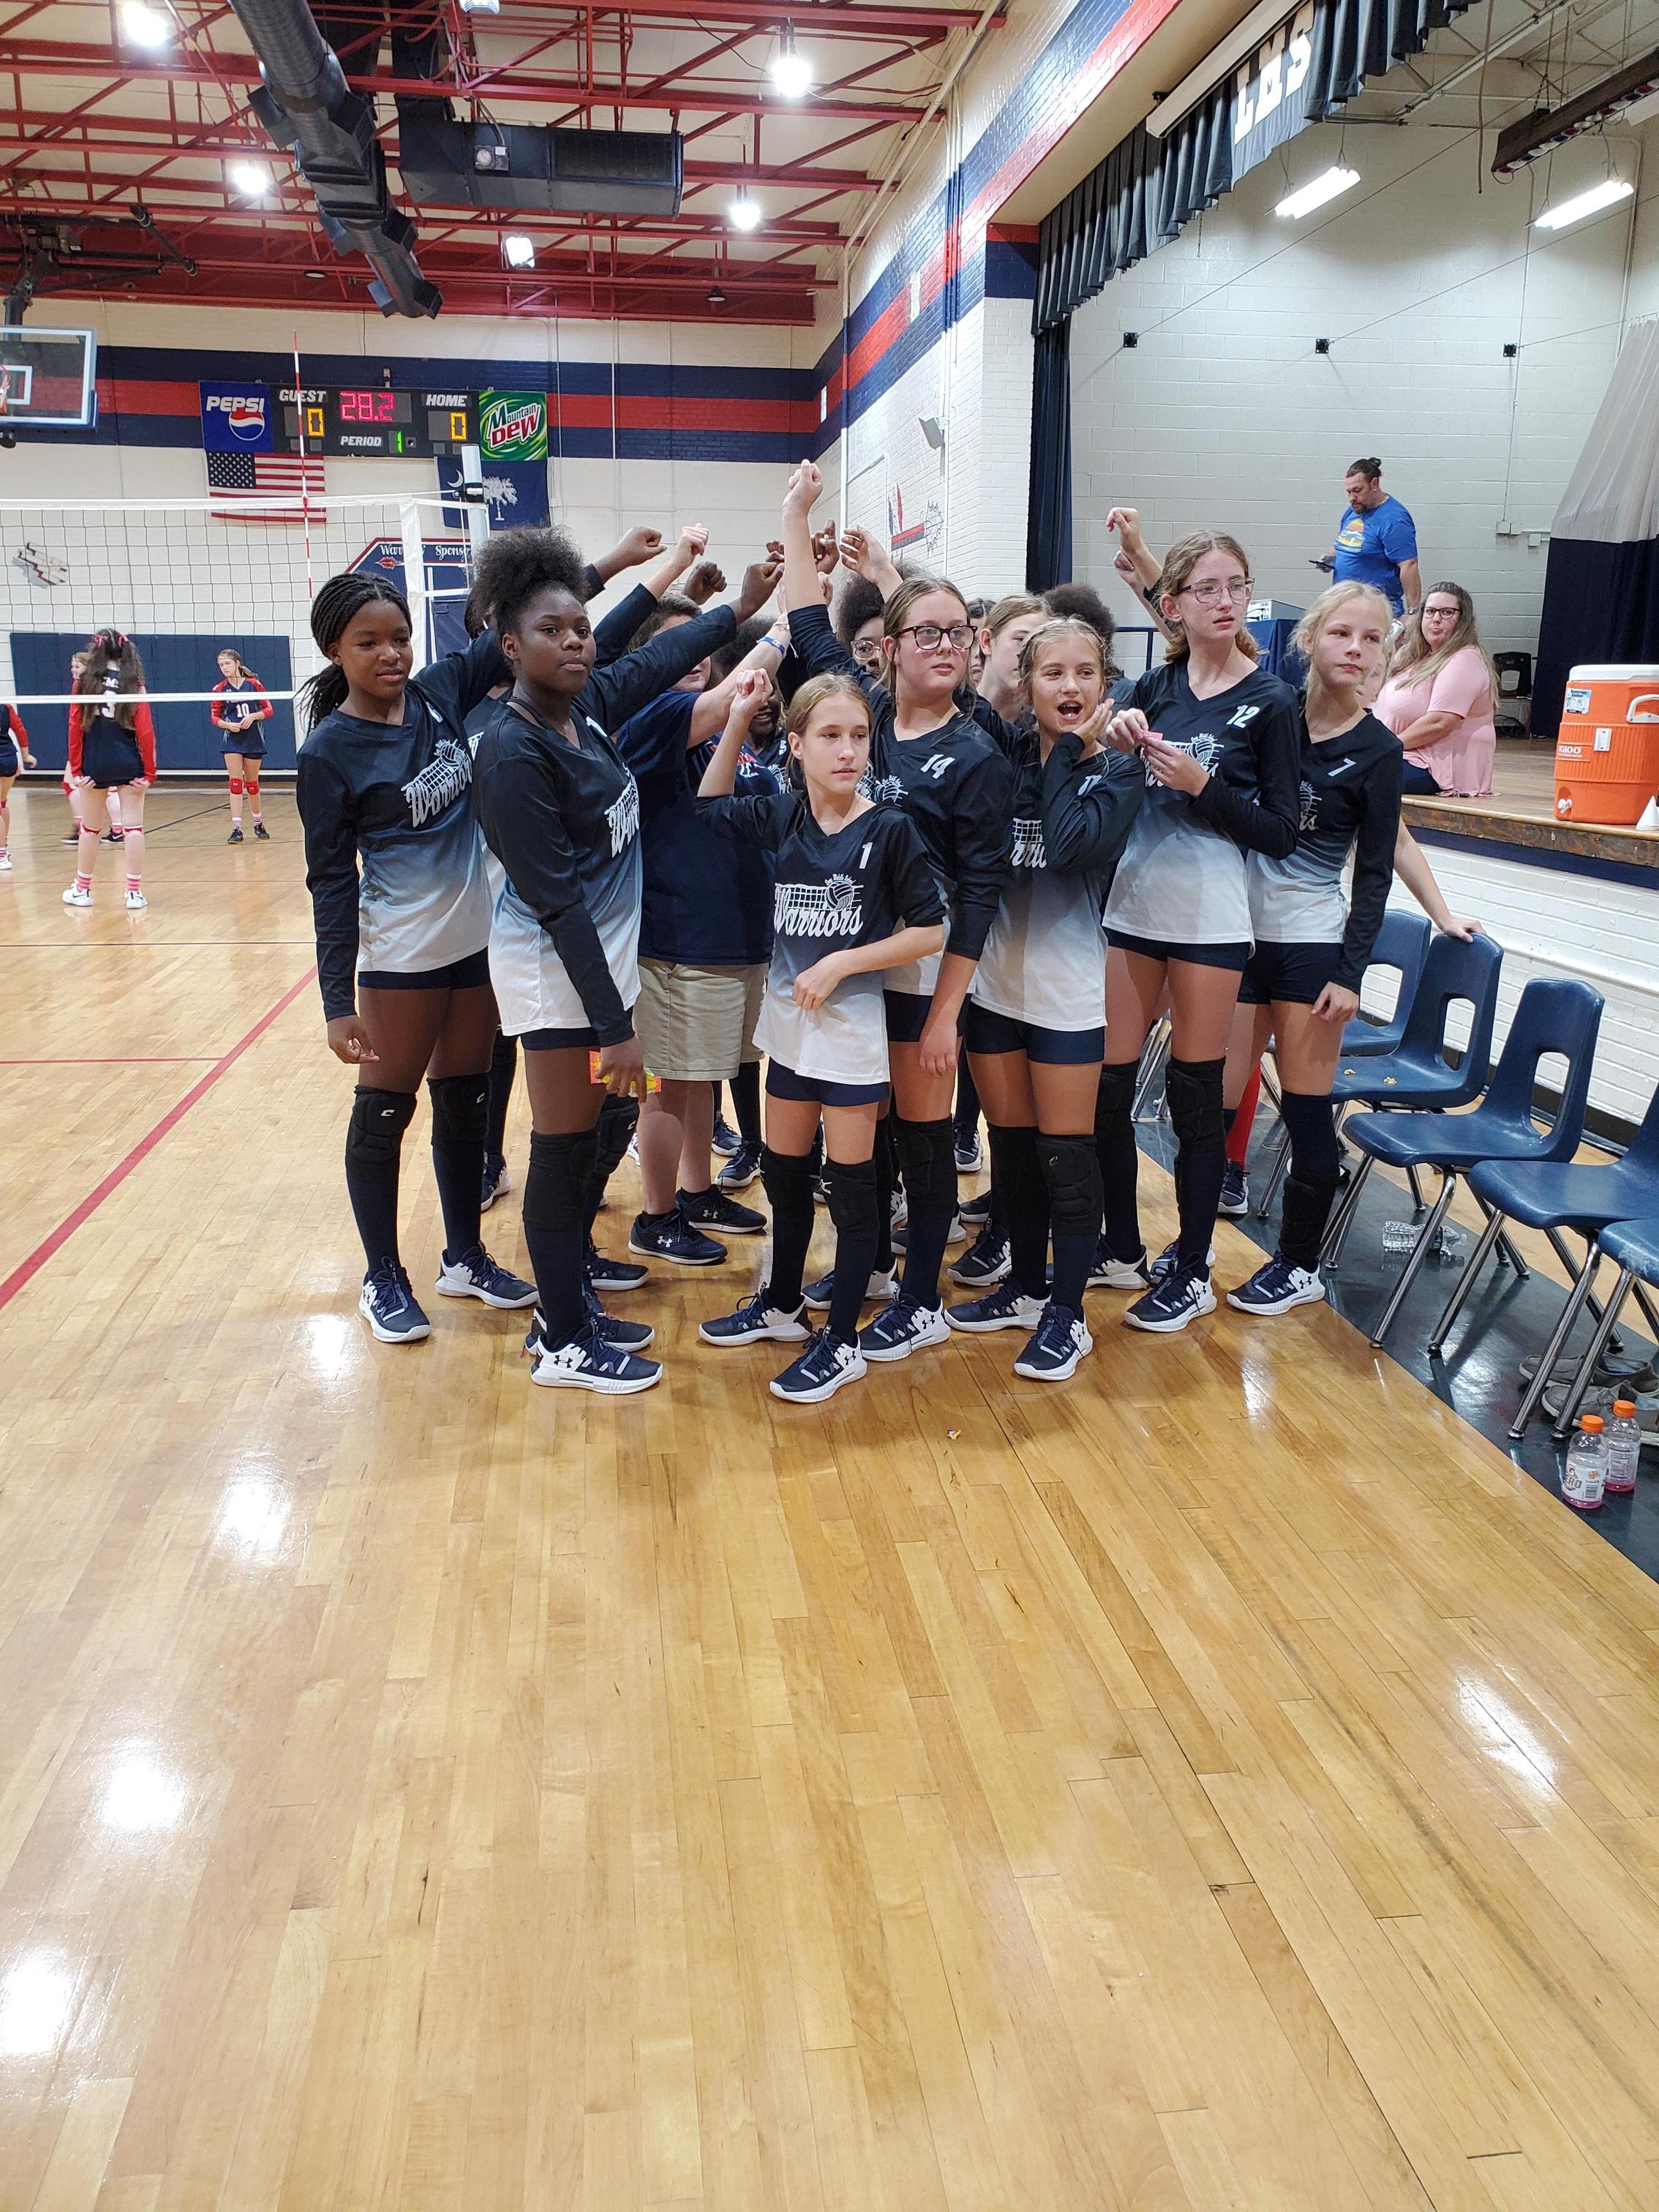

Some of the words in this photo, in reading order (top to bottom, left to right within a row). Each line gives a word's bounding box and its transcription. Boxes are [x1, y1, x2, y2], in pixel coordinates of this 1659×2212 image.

[1234, 0, 1314, 146] LMS
[206, 396, 265, 413] PEPSI
[279, 389, 327, 402] GUEST
[339, 391, 394, 422] 28.2
[426, 394, 468, 407] HOME
[307, 408, 325, 436] 0
[451, 413, 467, 440] 0
[340, 436, 382, 447] PERIOD
[396, 431, 402, 454] 1
[236, 703, 249, 718] 10
[1226, 704, 1260, 729] 12
[920, 753, 955, 779] 14
[1327, 757, 1357, 777] 7
[859, 842, 873, 869] 1
[773, 886, 864, 937] Warriors
